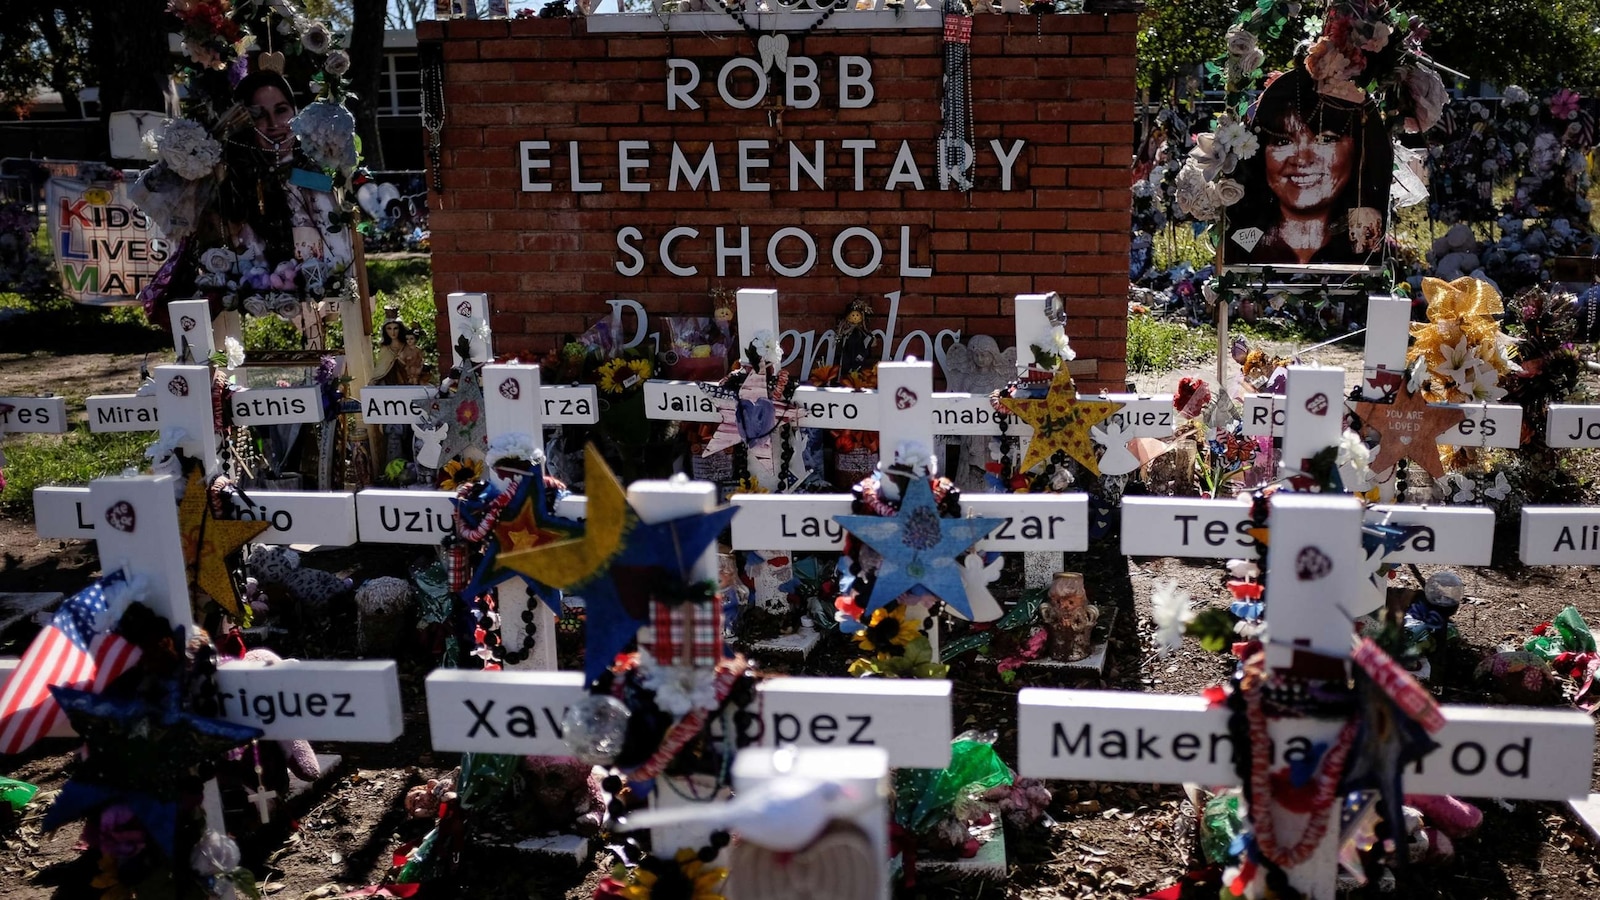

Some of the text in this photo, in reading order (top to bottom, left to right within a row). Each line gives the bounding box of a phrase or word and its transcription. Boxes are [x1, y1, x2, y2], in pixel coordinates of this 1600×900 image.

[666, 56, 875, 111] ROBB
[520, 138, 1026, 192] ELEMENTARY
[60, 199, 150, 228] KIDS
[61, 231, 169, 261] LIVES
[1239, 229, 1256, 241] EVA
[615, 226, 933, 278] SCHOOL
[231, 396, 306, 418] athis
[366, 397, 591, 417] Ame rza
[657, 391, 719, 413] Jaila
[1386, 409, 1425, 420] YOU ARE
[1252, 406, 1497, 436] Ro es
[1388, 422, 1421, 431] LOVED
[1568, 416, 1600, 440] Jo
[780, 513, 1065, 543] Lay zar
[1174, 514, 1257, 548] Tes
[1552, 525, 1600, 552] Ali
[217, 688, 356, 725] riguez
[462, 698, 565, 740] Xav
